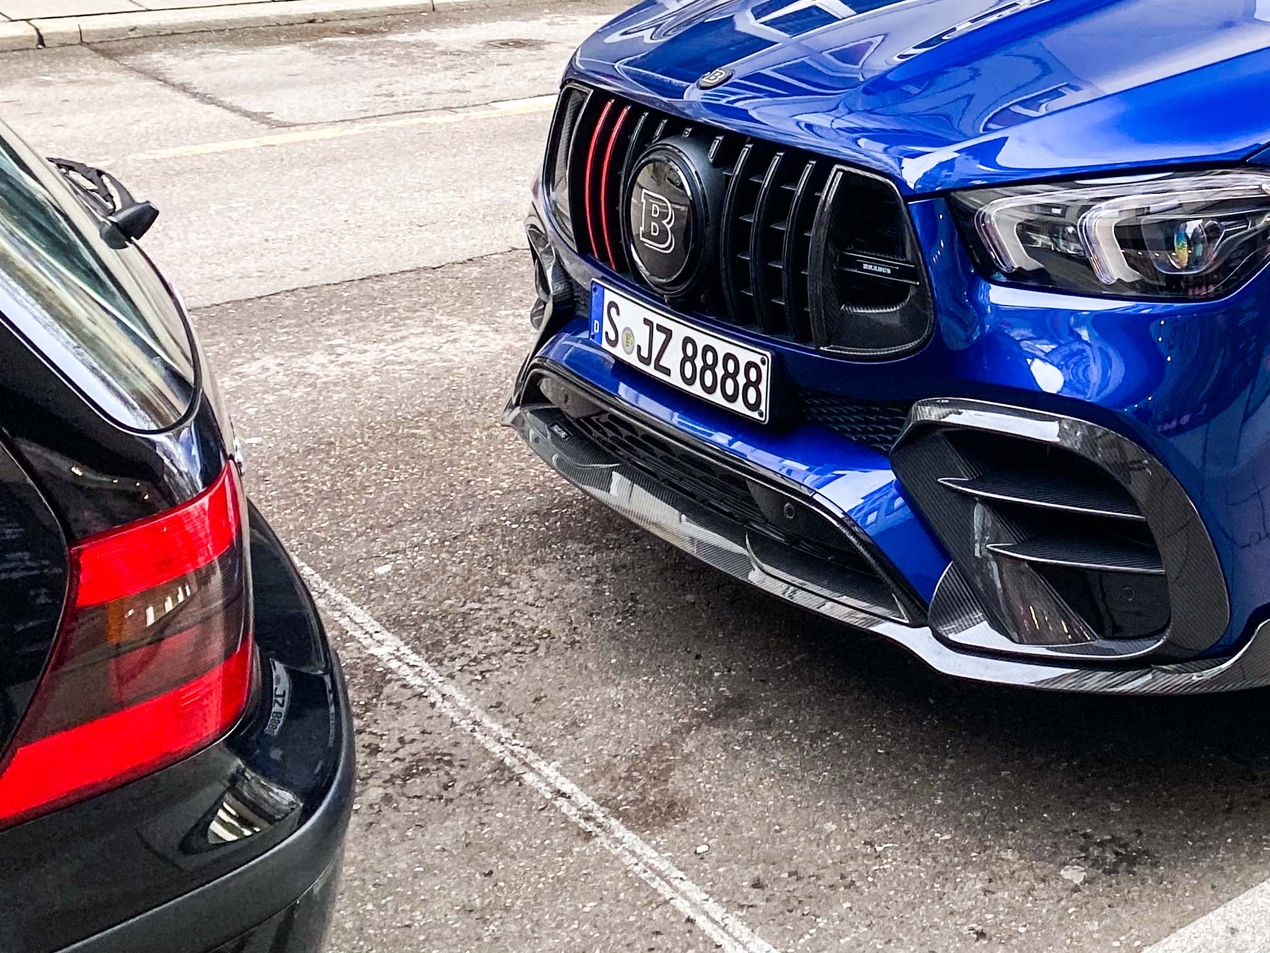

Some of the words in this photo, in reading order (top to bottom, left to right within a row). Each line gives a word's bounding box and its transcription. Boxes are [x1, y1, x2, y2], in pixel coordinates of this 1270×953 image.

[702, 69, 726, 84] B
[640, 188, 675, 254] B
[593, 319, 600, 334] D
[604, 300, 621, 348] S
[636, 317, 673, 377] JZ
[679, 336, 763, 412] 8888
